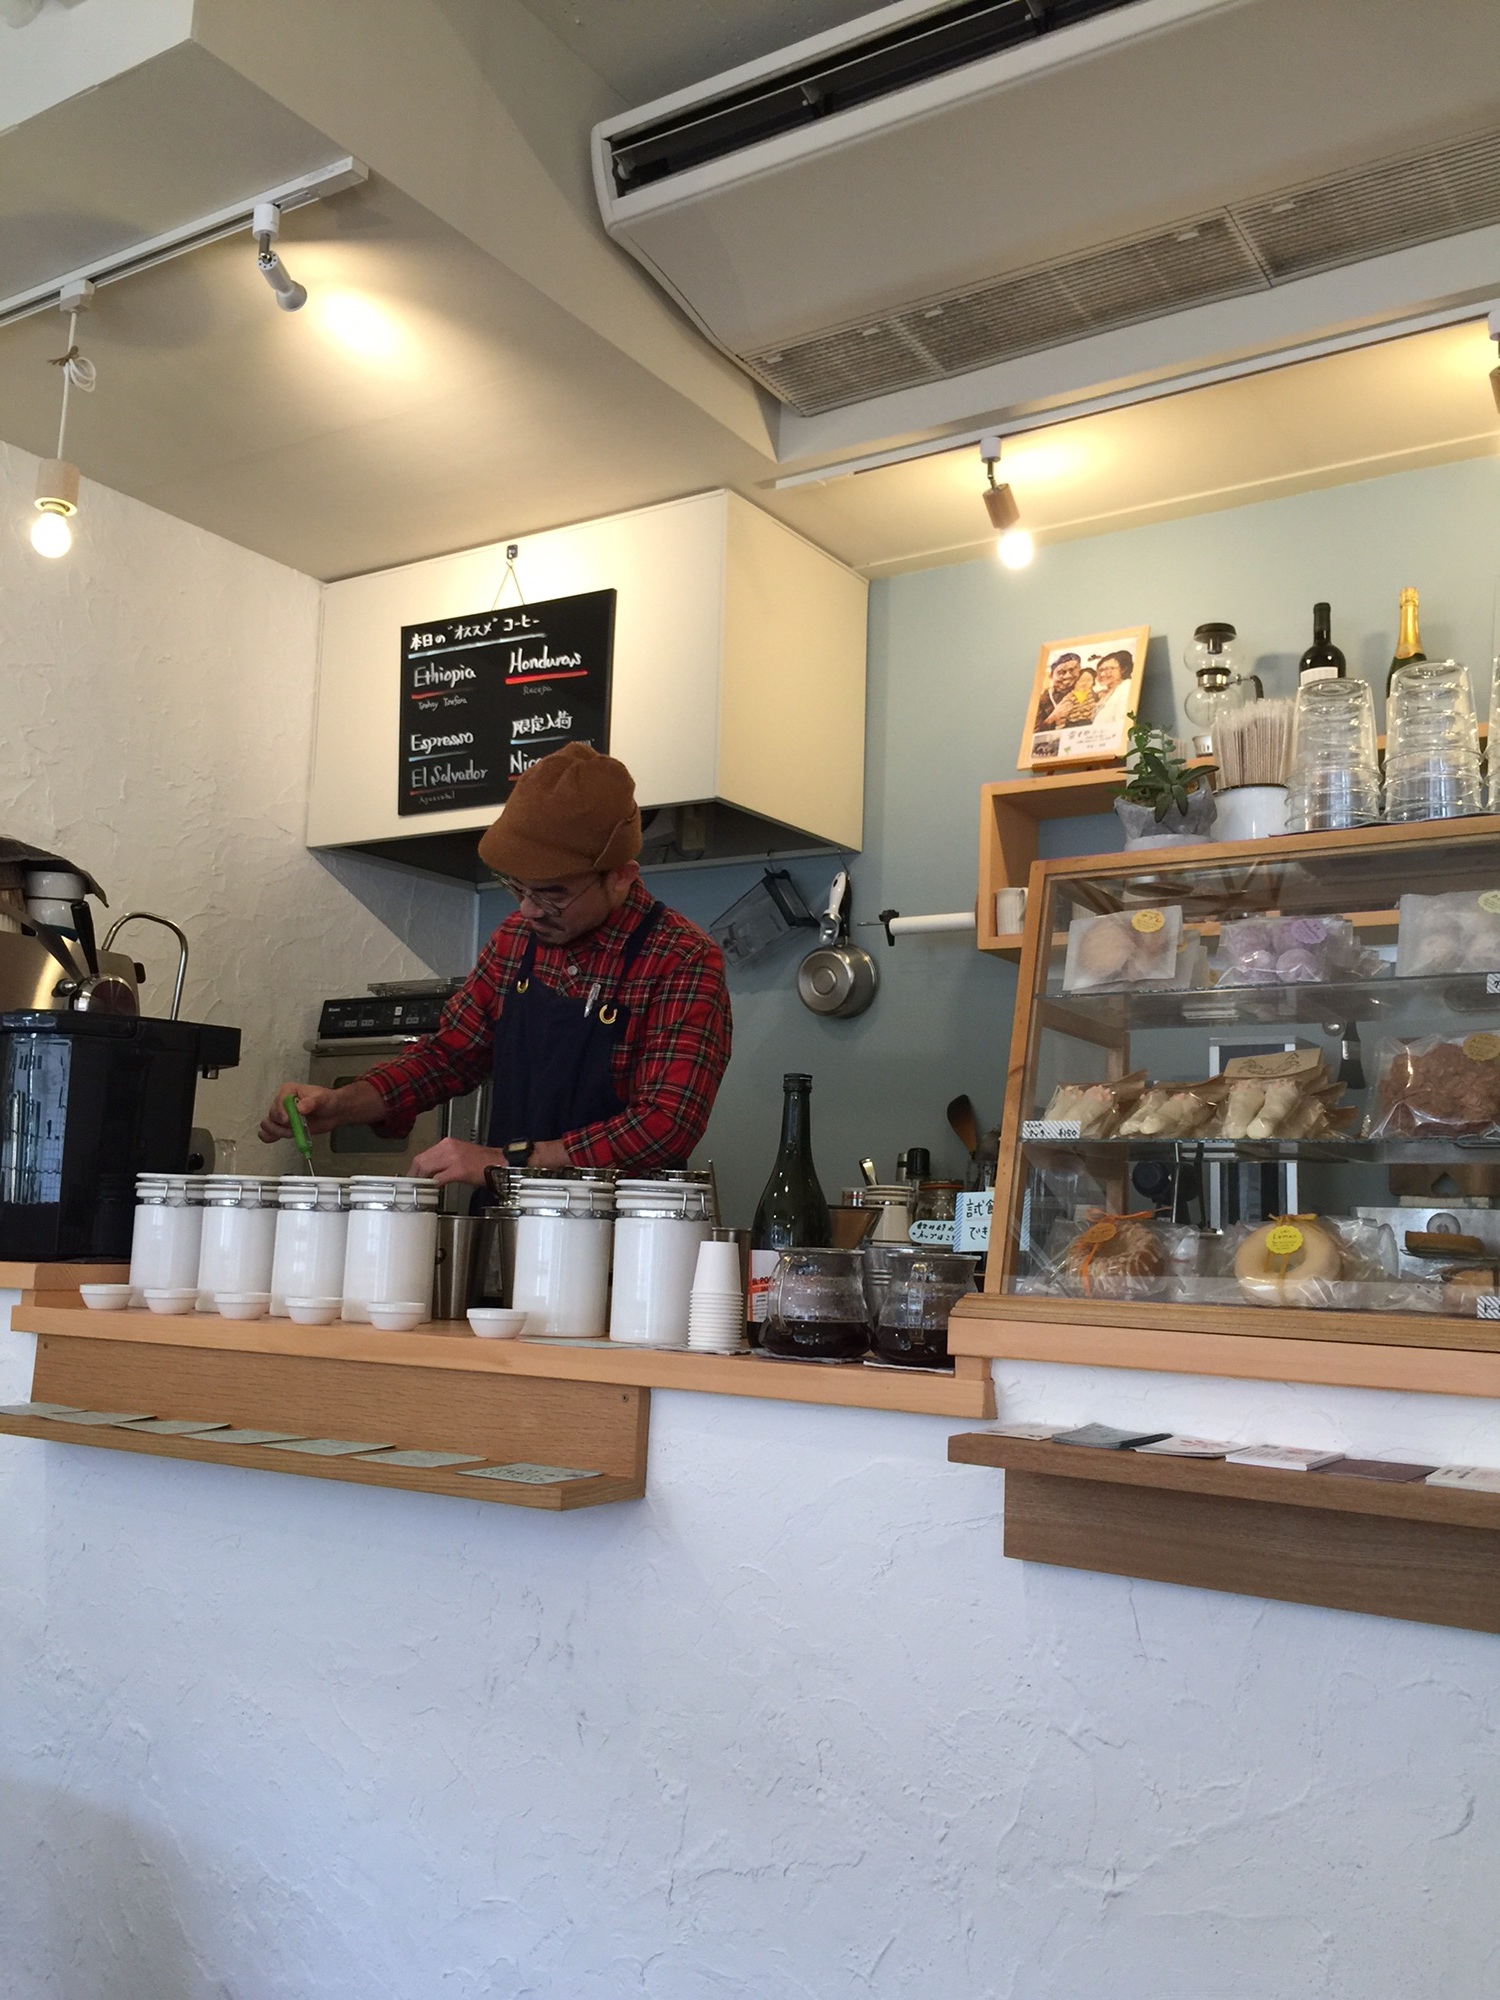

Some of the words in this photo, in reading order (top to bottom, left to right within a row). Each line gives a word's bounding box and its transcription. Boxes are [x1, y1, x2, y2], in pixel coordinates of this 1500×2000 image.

[409, 632, 446, 651] 本日の
[503, 613, 540, 632] コーヒー
[508, 645, 582, 674] Honduras
[414, 662, 477, 688] Ethiopia
[511, 709, 573, 738] 限定入荷
[411, 732, 474, 755] Espresso
[412, 766, 427, 788] El
[430, 759, 489, 786] Salvador
[969, 1225, 989, 1241] でき
